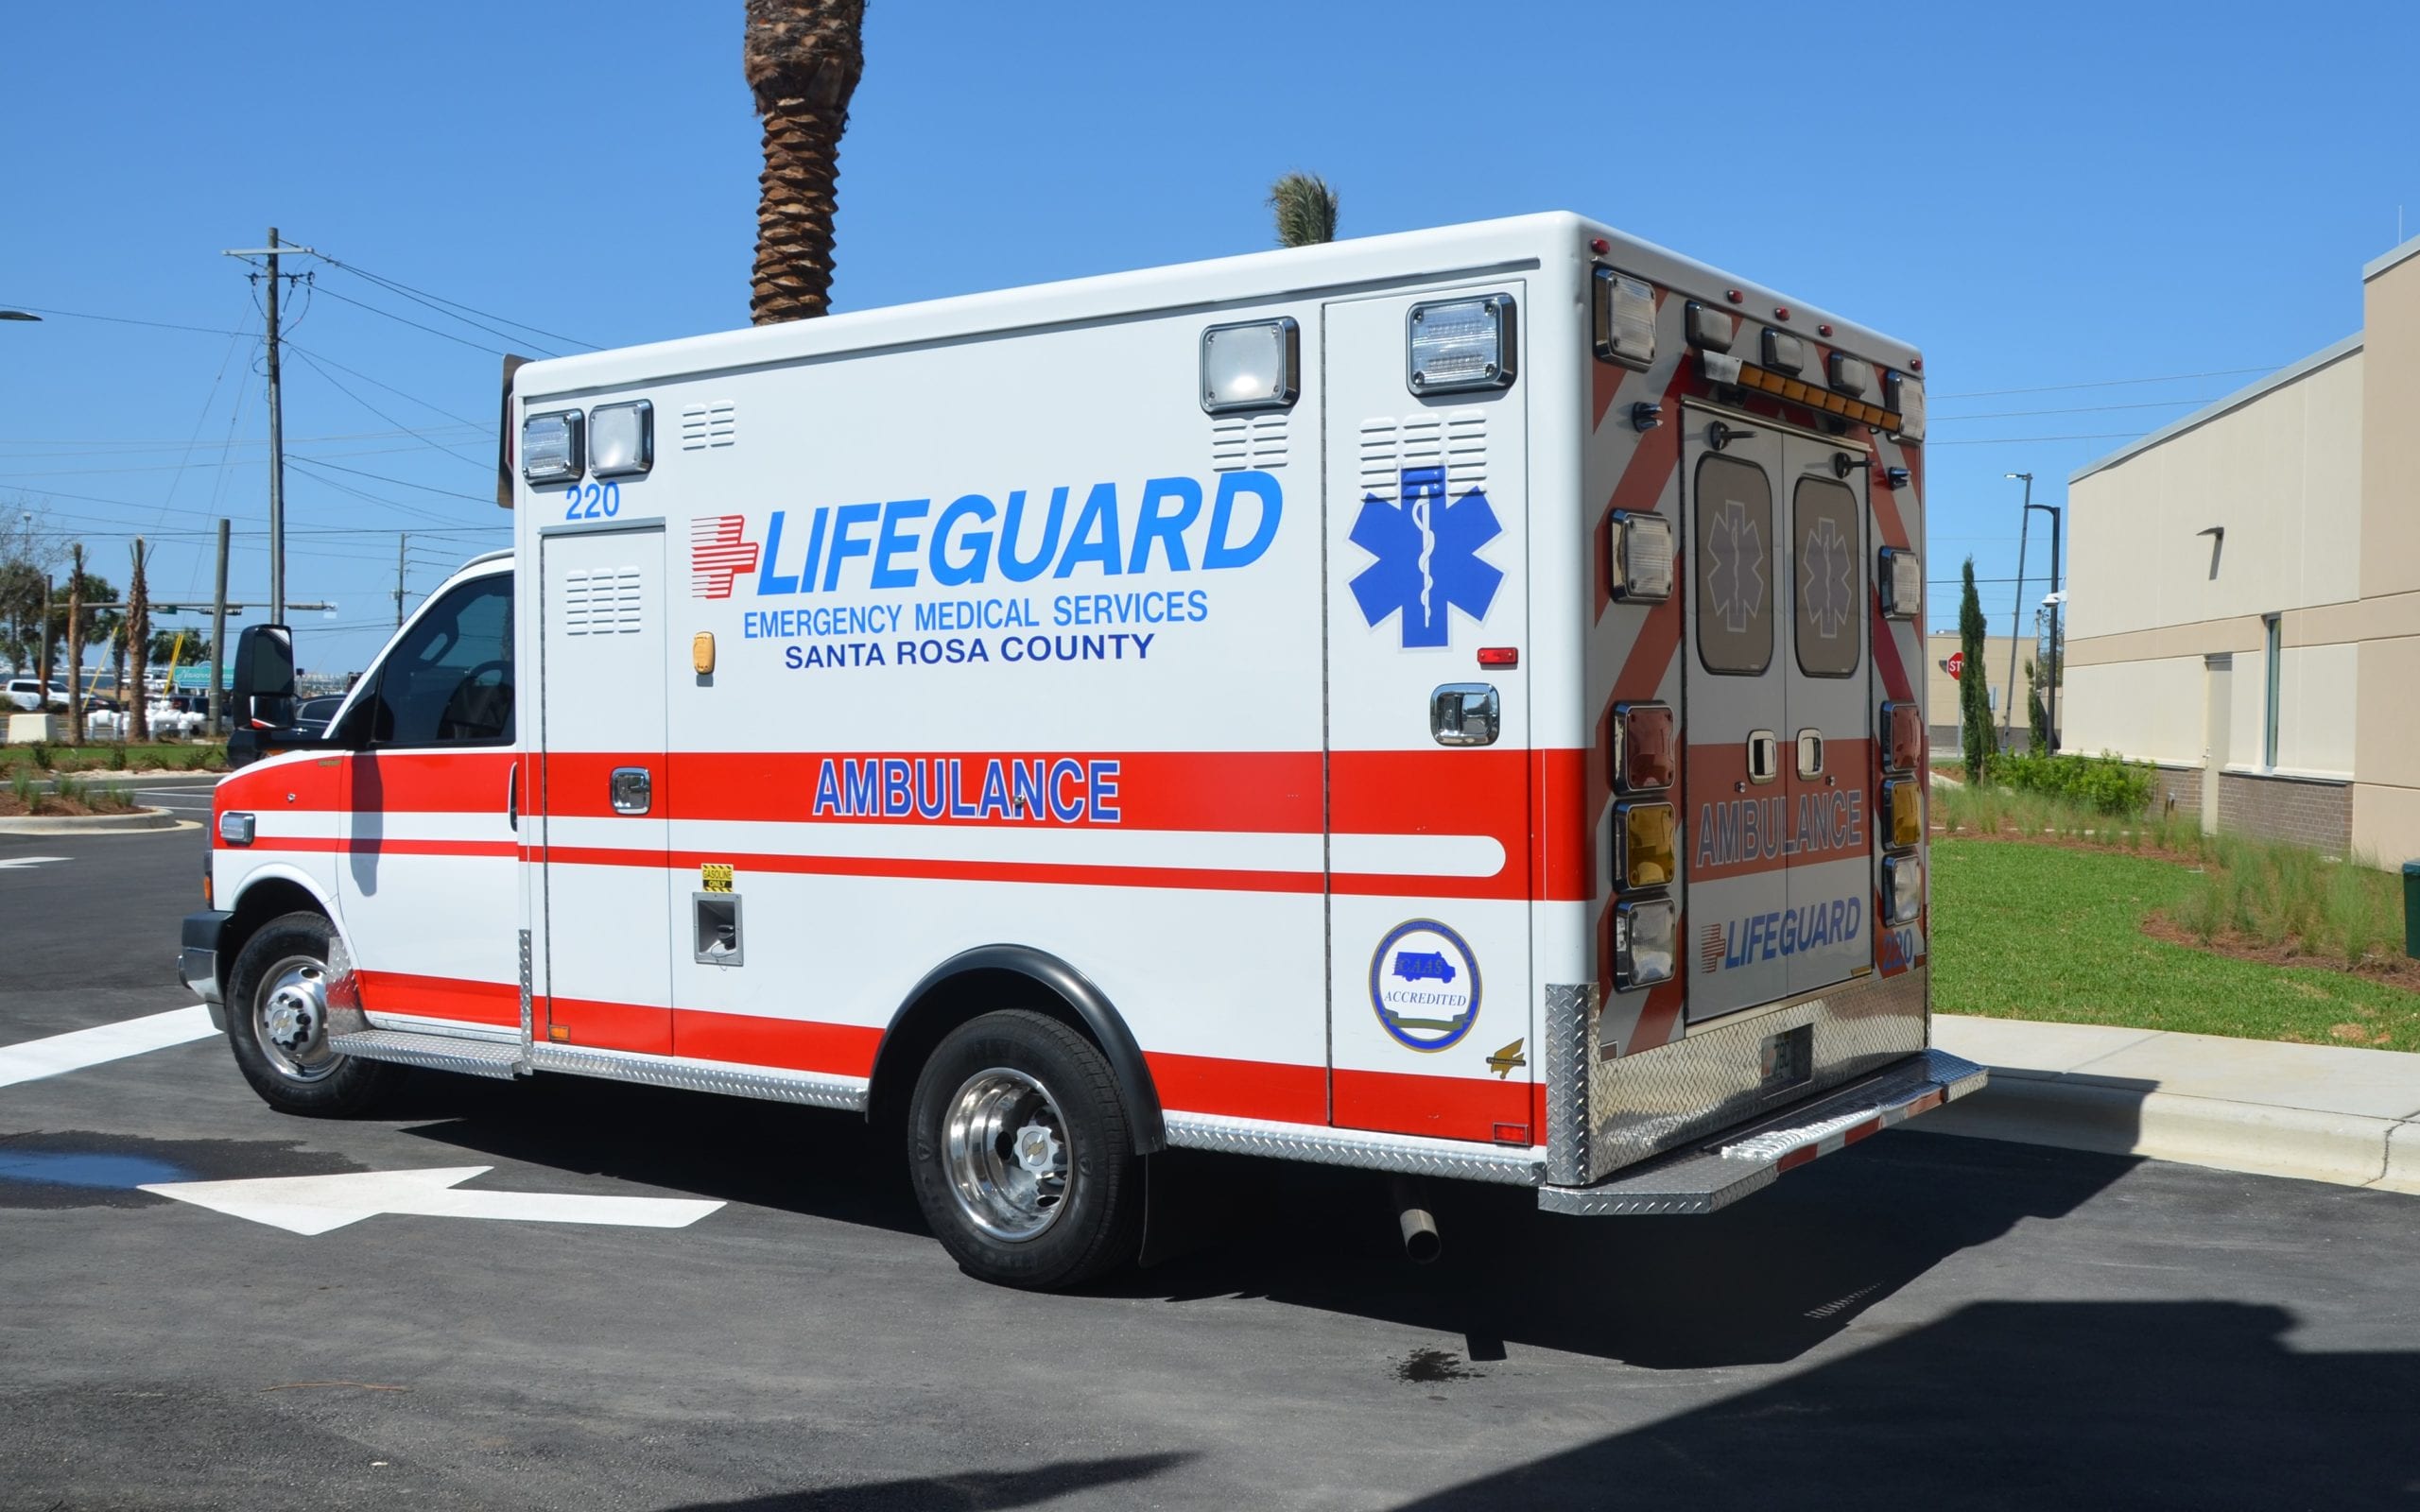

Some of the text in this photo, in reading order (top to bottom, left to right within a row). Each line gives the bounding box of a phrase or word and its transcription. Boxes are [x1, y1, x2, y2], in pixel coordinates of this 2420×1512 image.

[565, 480, 620, 521] 220
[757, 471, 1283, 595] LIFEGUARD
[744, 590, 1208, 639] EMERGENCY MEDICAL SERVICES
[785, 632, 1155, 670] SANTA ROSA COUNTY
[812, 757, 1121, 823] AMBULANCE
[1696, 789, 1862, 868] AMBULANCE
[703, 869, 732, 879] GASOLINE
[1724, 896, 1862, 970] LIFEGUARD
[1882, 928, 1913, 970] 220
[1383, 990, 1467, 1006] ACCREDITED
